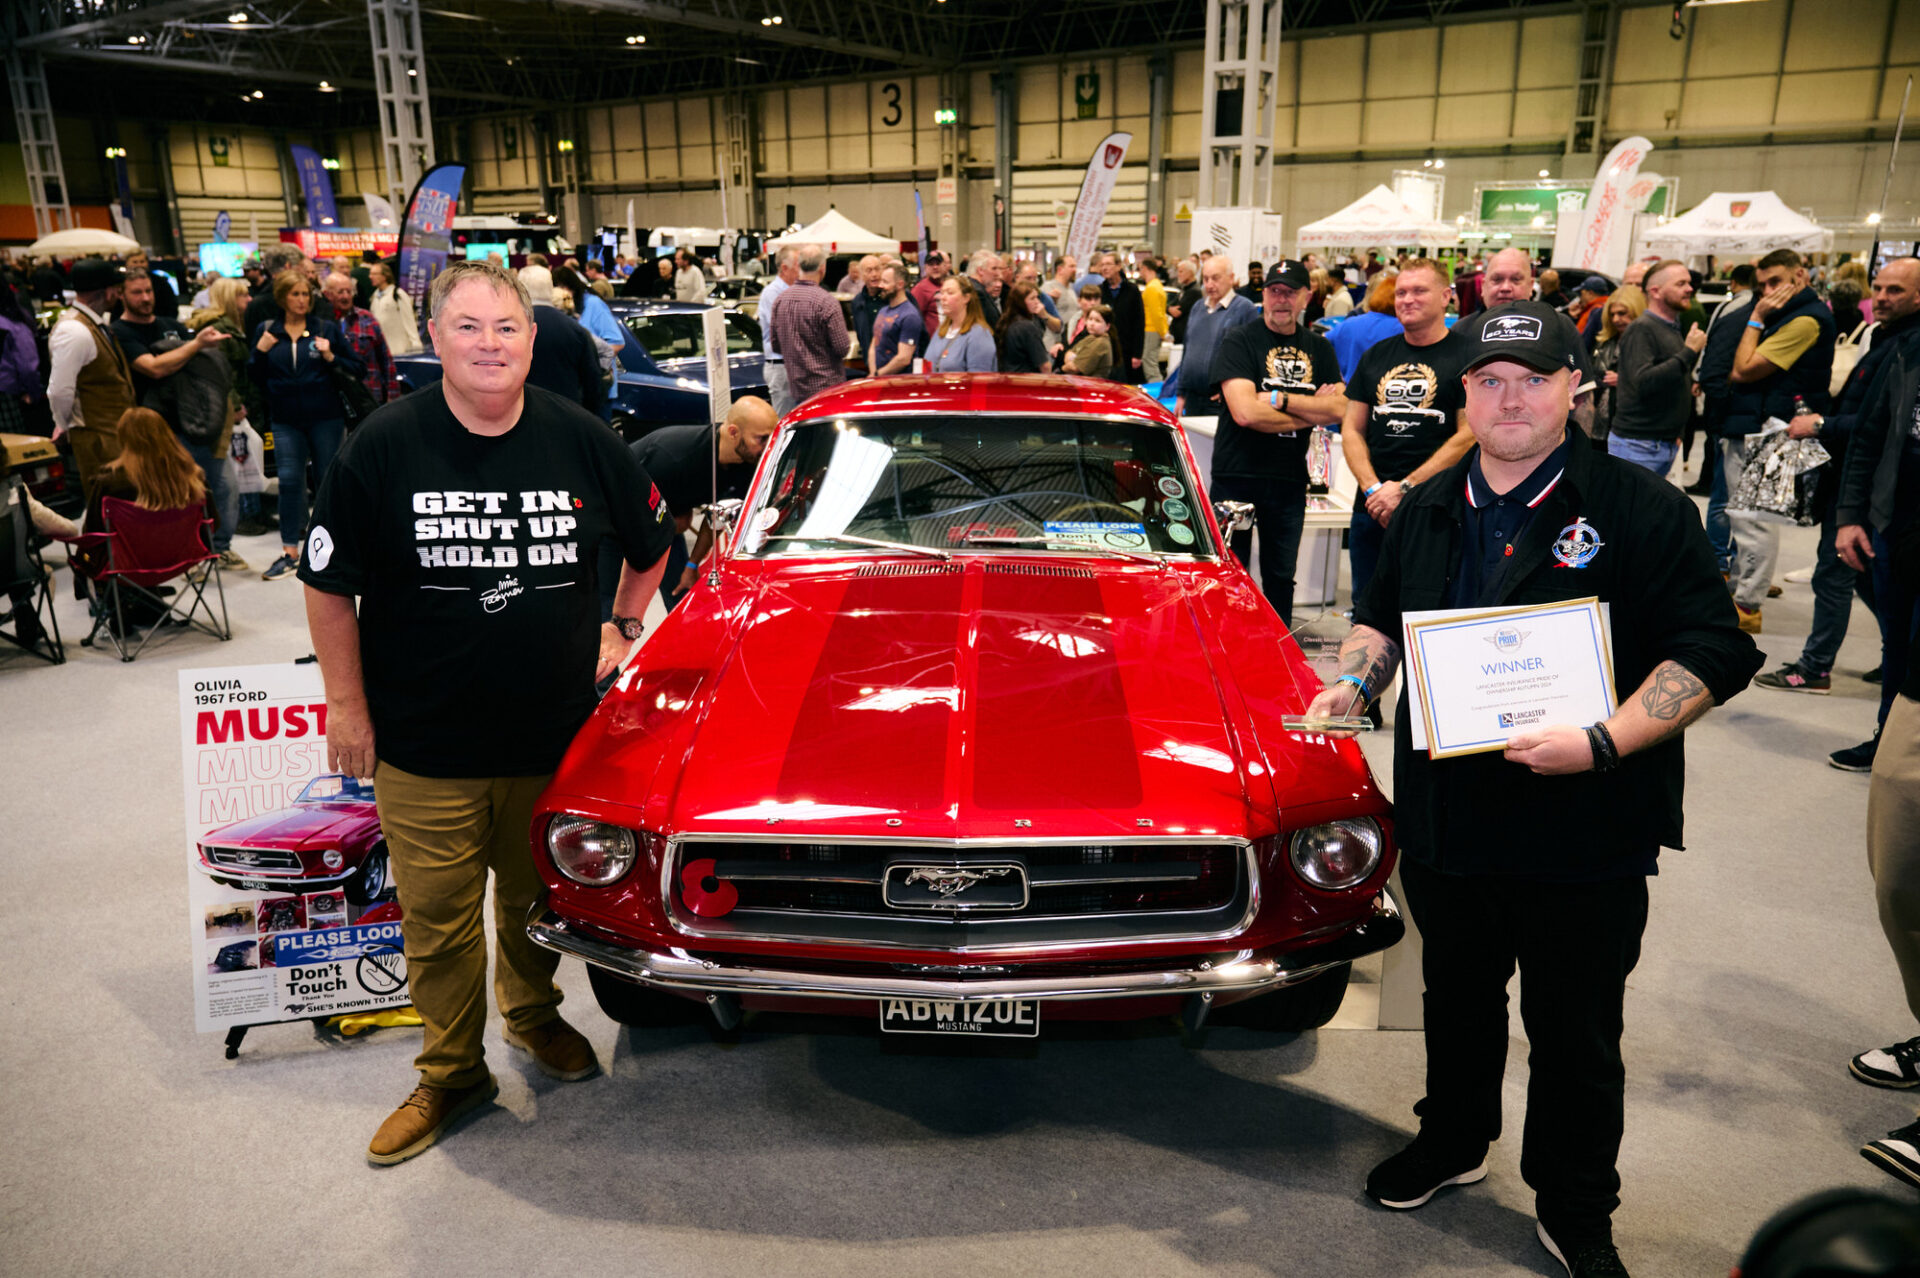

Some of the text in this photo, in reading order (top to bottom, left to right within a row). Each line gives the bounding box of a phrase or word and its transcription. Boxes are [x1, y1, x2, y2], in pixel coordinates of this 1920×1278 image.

[882, 82, 902, 126] 3
[1503, 329, 1535, 338] YEARS
[1384, 379, 1429, 399] 60
[412, 490, 573, 515] GET IN
[415, 515, 577, 540] SHUT UP
[416, 542, 578, 568] HOLD ON
[1498, 634, 1517, 644] PRIDE
[1481, 657, 1544, 676] WINNER
[194, 679, 242, 692] OLIVIA
[194, 691, 267, 705] 1967 FORD
[1513, 708, 1546, 720] LANCASTER
[1514, 717, 1540, 726] INSURANCE
[278, 930, 351, 951] PLEASE
[290, 963, 342, 982] Don't
[286, 977, 347, 996] Touch
[307, 1003, 334, 1013] SHE'S
[336, 999, 371, 1009] KNOWN
[373, 996, 385, 1005] TO
[937, 1021, 982, 1032] MUSTANG
